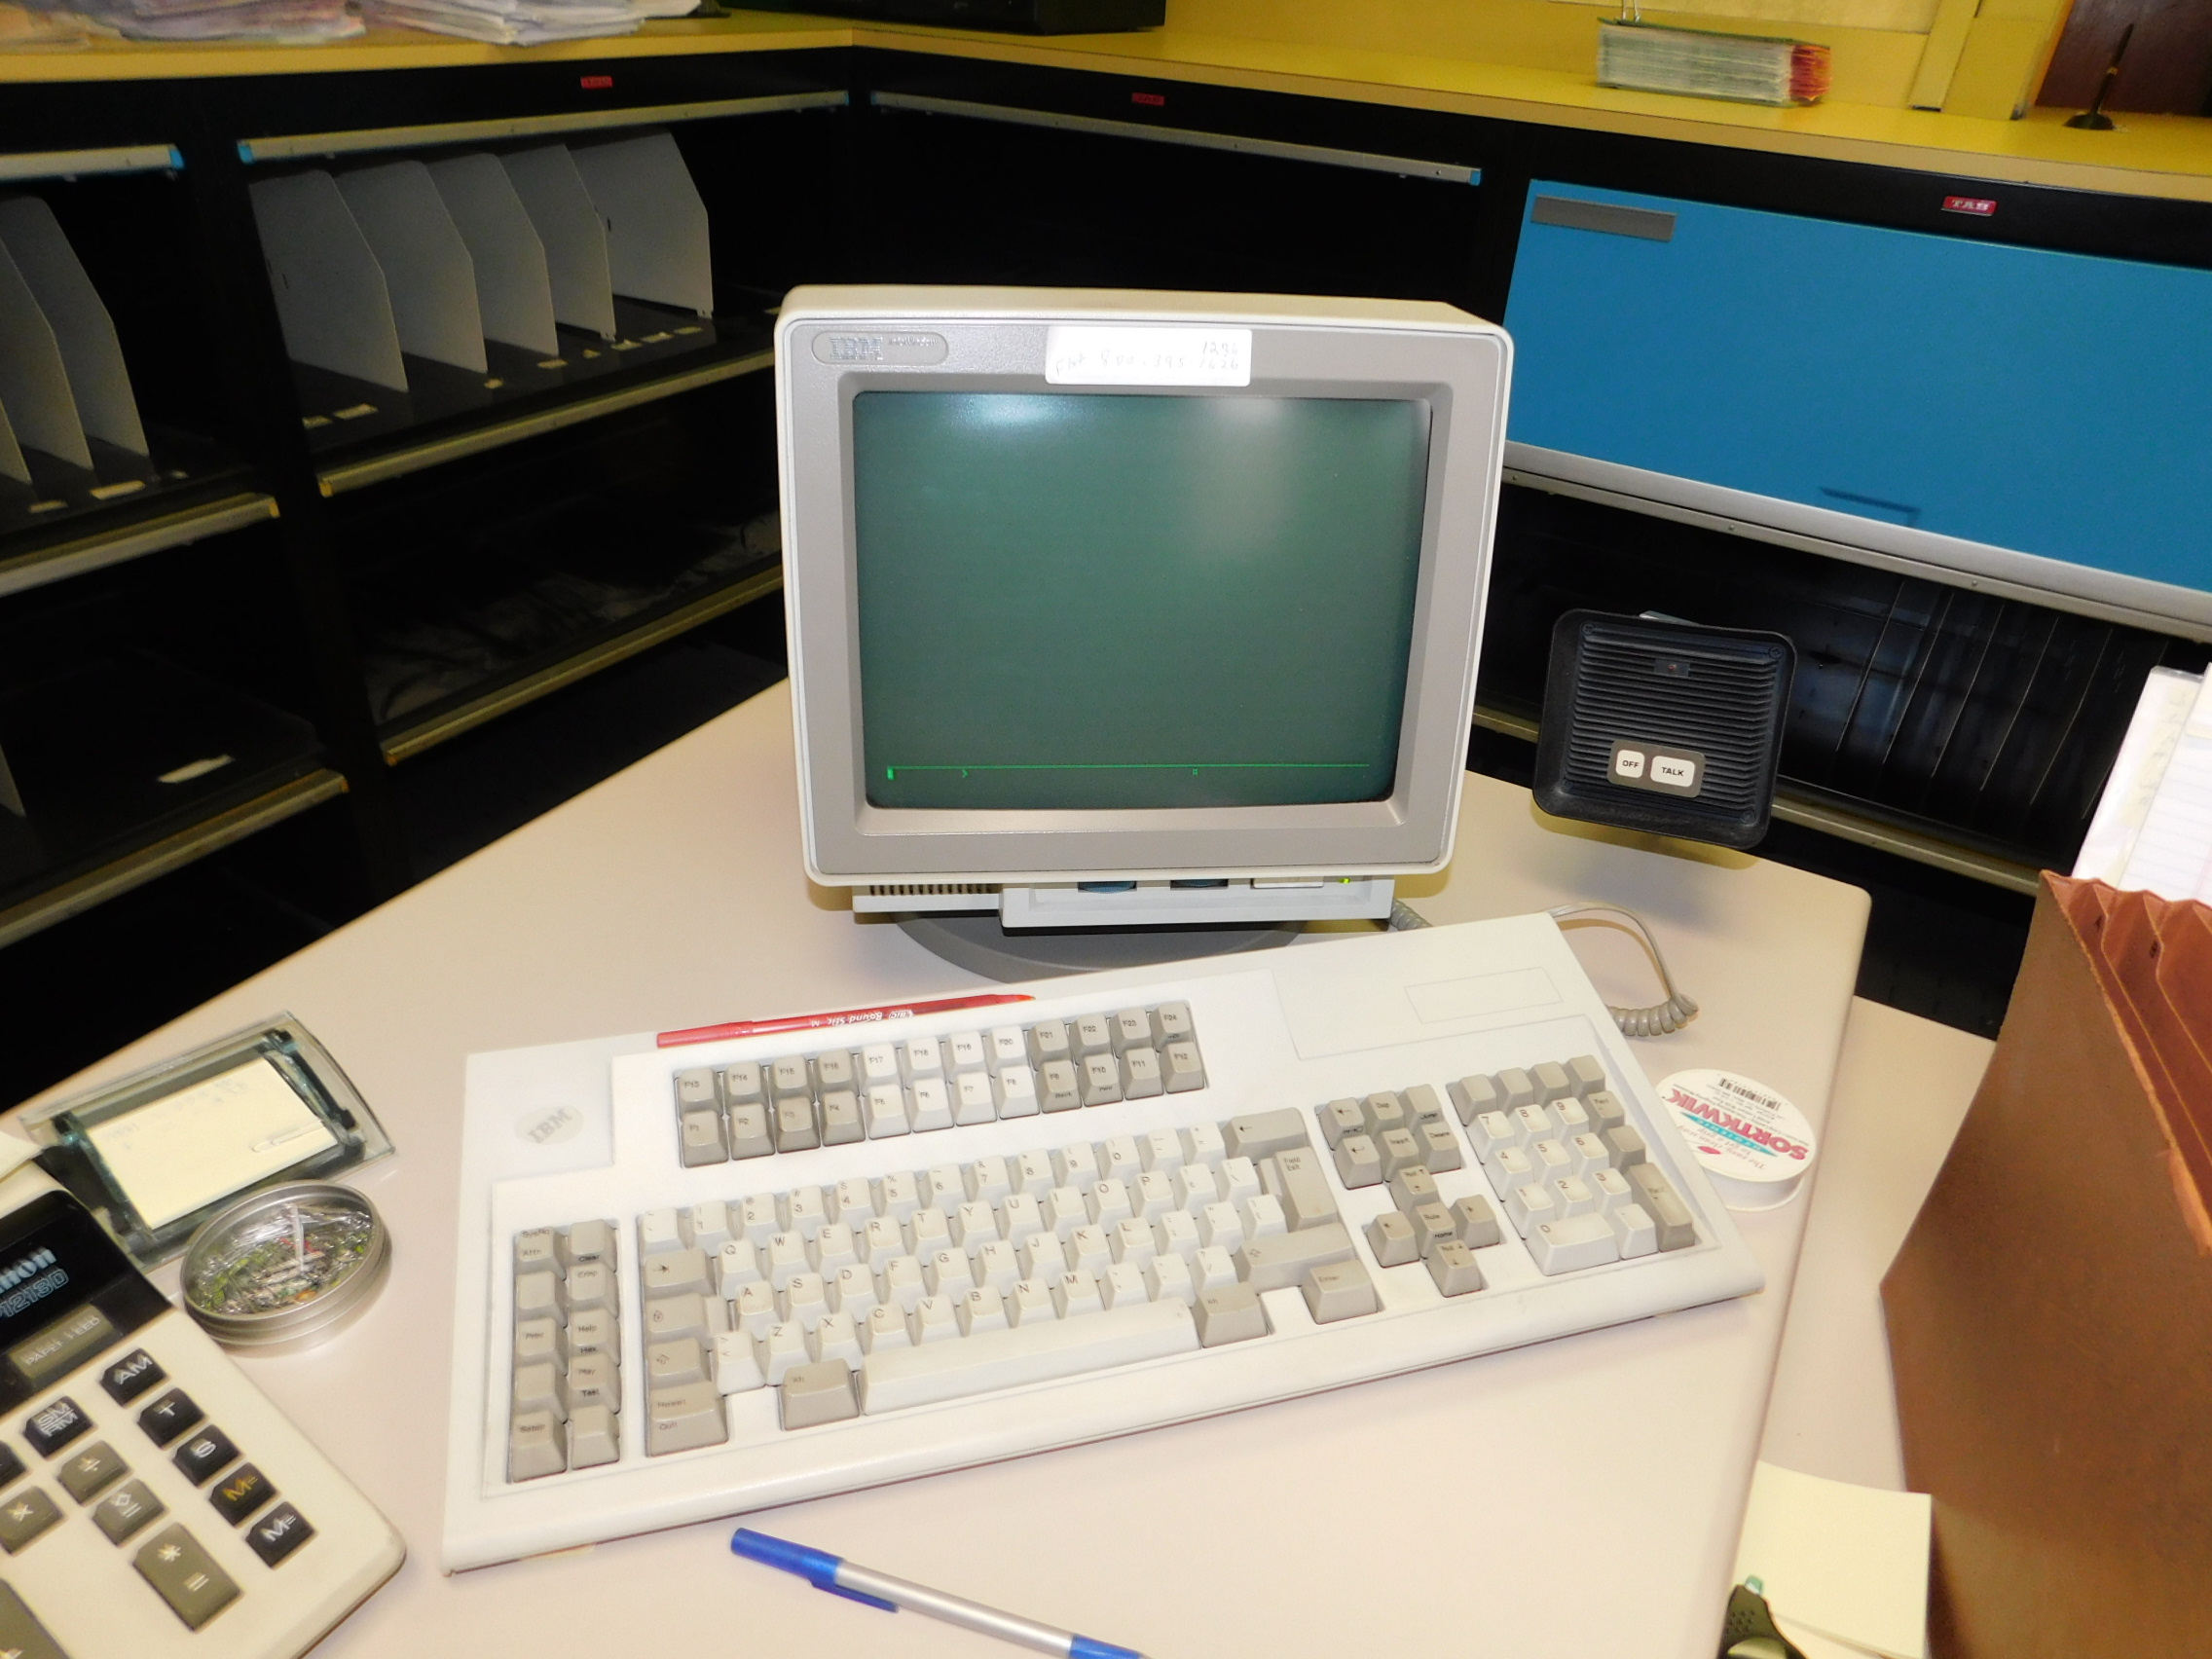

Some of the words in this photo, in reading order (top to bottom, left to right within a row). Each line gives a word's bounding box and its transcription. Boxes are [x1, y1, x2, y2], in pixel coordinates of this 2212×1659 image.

[1951, 199, 1989, 211] TAB
[830, 337, 883, 360] IBM
[1622, 759, 1640, 769] OFF
[1661, 766, 1684, 777] TALK
[828, 1016, 847, 1026] Stic
[849, 1011, 883, 1023] Round
[1163, 1014, 1178, 1022] F24
[1083, 1025, 1097, 1034] F22
[999, 1038, 1014, 1047] F20
[869, 1055, 884, 1064] F17
[1174, 1052, 1189, 1061] F12
[1092, 1066, 1107, 1075] F10
[732, 1073, 748, 1083] F14
[1557, 1101, 1567, 1111] 9
[1520, 1109, 1529, 1118] 8
[1481, 1115, 1490, 1125] 7
[1667, 1088, 1809, 1161] SORTKWIK
[528, 1108, 573, 1144] IBM
[1574, 1137, 1585, 1147] 6
[1537, 1143, 1548, 1153] 5
[1500, 1152, 1508, 1161] 4
[1140, 1176, 1151, 1186] P
[1596, 1172, 1606, 1182] 3
[1098, 1183, 1110, 1194] O
[1558, 1179, 1568, 1190] 2
[1010, 1198, 1019, 1209] U
[963, 1205, 974, 1216] Y
[916, 1213, 927, 1223] T
[870, 1221, 881, 1232] R
[1121, 1222, 1131, 1232] L
[822, 1229, 831, 1239] E
[1076, 1230, 1088, 1240] K
[774, 1236, 786, 1247] W
[1031, 1237, 1041, 1248] J
[522, 1248, 542, 1257] Attn
[725, 1244, 737, 1256] Q
[984, 1245, 997, 1256] H
[578, 1253, 601, 1263] Clear
[939, 1253, 949, 1264] G
[0, 1248, 57, 1294] non
[890, 1261, 899, 1272] F
[842, 1270, 853, 1280] D
[1065, 1274, 1079, 1285] M
[793, 1278, 803, 1289] S
[1018, 1283, 1030, 1294] N
[0, 1268, 70, 1318] 1213D
[743, 1287, 754, 1298] A
[971, 1291, 982, 1302] B
[922, 1299, 934, 1310] V
[874, 1308, 885, 1319] C
[823, 1317, 834, 1328] X
[577, 1324, 598, 1333] Help
[773, 1326, 783, 1338] Z
[580, 1346, 598, 1355] Hex
[116, 1354, 154, 1385] AM
[580, 1388, 600, 1398] Test
[38, 1402, 71, 1426] SM
[158, 1401, 176, 1417] T
[43, 1411, 79, 1438] RM
[659, 1420, 678, 1431] Quit
[194, 1440, 217, 1458] S
